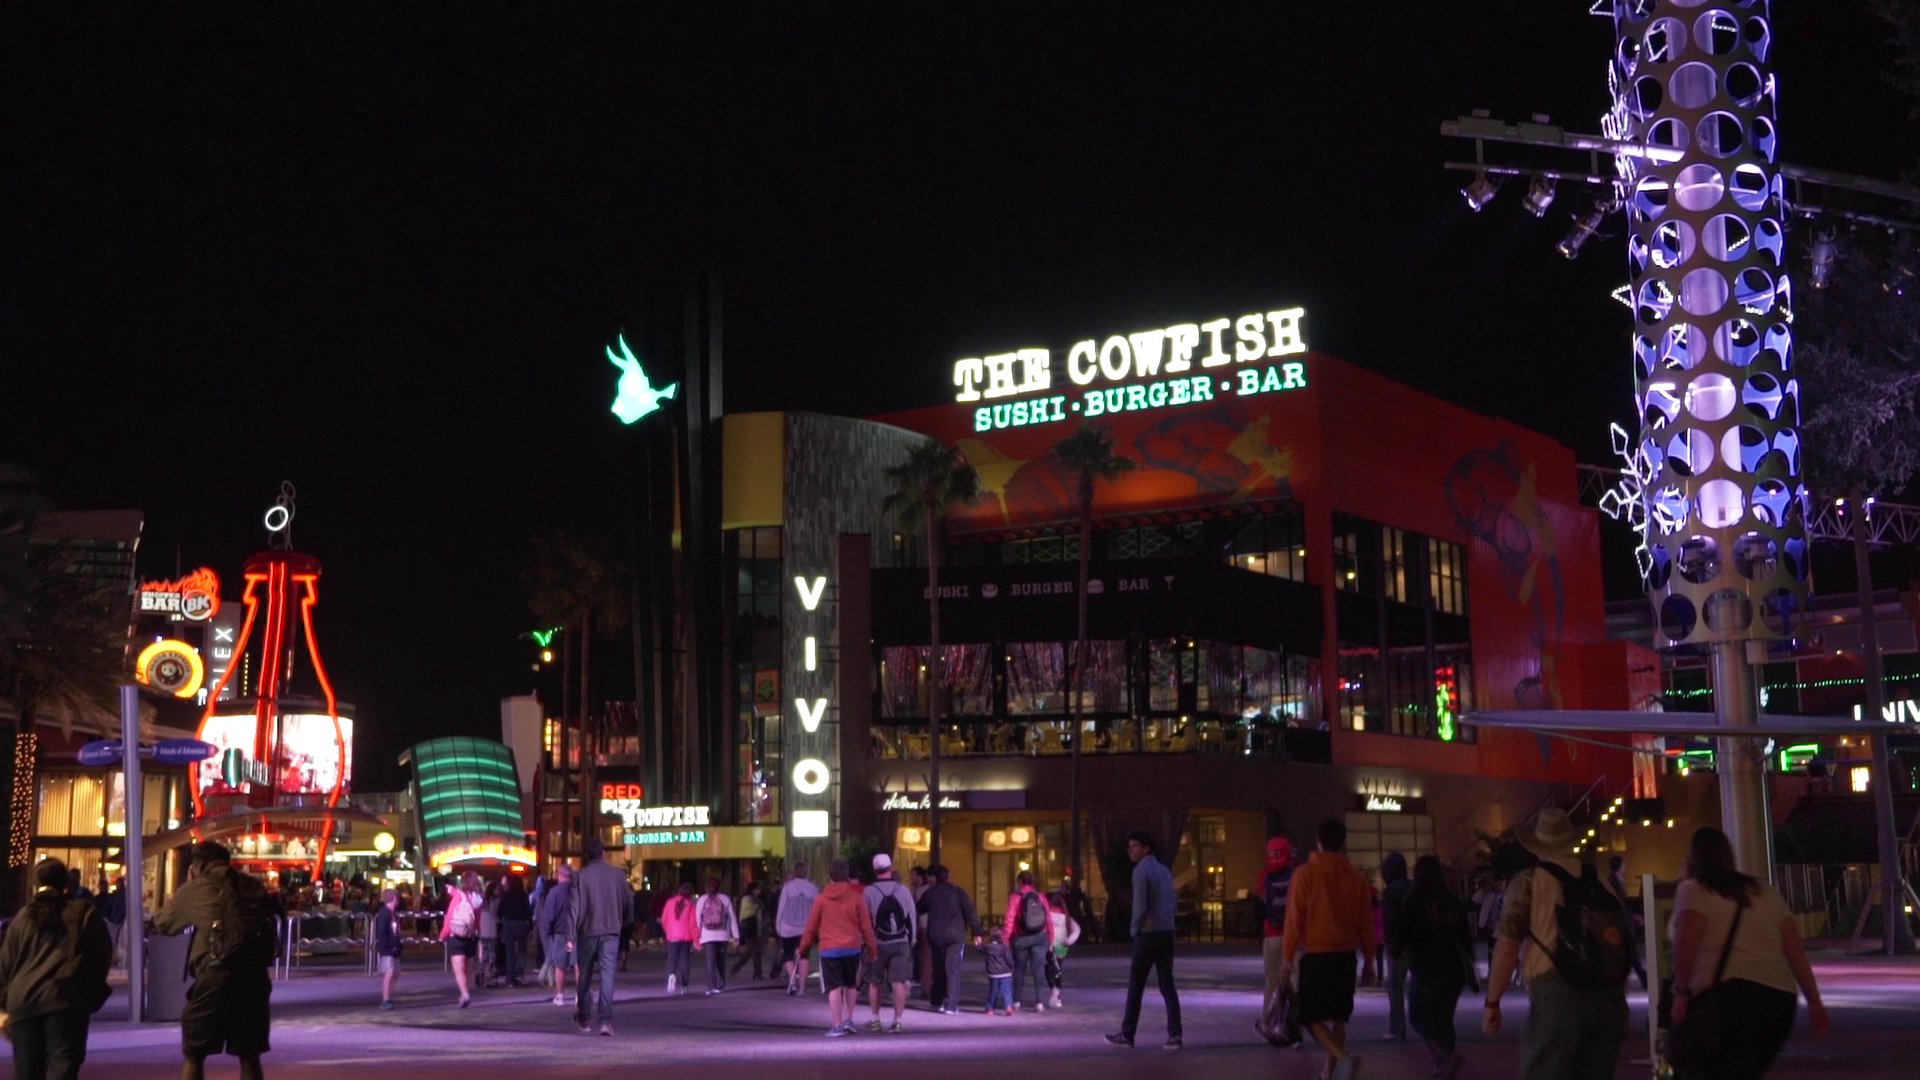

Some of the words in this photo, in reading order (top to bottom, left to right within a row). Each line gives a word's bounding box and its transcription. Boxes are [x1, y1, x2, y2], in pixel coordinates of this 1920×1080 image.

[953, 349, 1051, 402] THE
[1068, 307, 1307, 386] COWFISH
[975, 396, 1066, 432] SUSHI
[1084, 375, 1214, 418] BURGER
[1237, 362, 1307, 397] BAR
[1011, 581, 1074, 596] BURGER
[1118, 578, 1149, 591] BAR
[141, 597, 180, 611] BAR
[187, 595, 210, 613] BK
[793, 576, 830, 795] VIVO
[1854, 700, 1920, 722] NIV
[602, 785, 641, 799] RED
[1362, 777, 1403, 794] VIVO
[638, 832, 673, 843] BURGER
[680, 831, 705, 842] BAR
